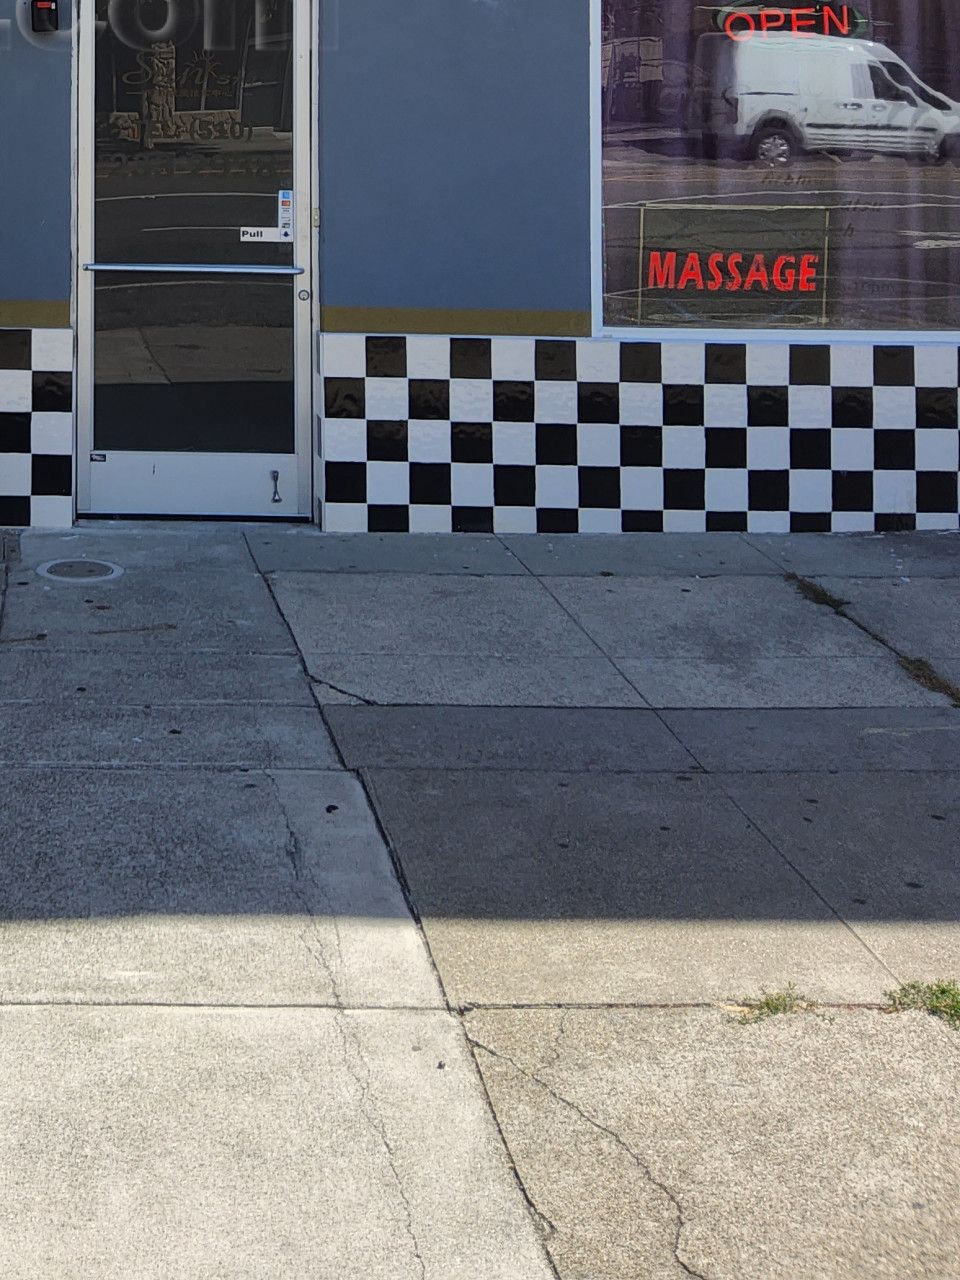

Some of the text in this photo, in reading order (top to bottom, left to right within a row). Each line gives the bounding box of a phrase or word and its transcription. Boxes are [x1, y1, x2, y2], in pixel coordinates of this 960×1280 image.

[725, 5, 850, 42] OPEN
[242, 230, 263, 238] Pull
[648, 251, 819, 292] MASSAGE
